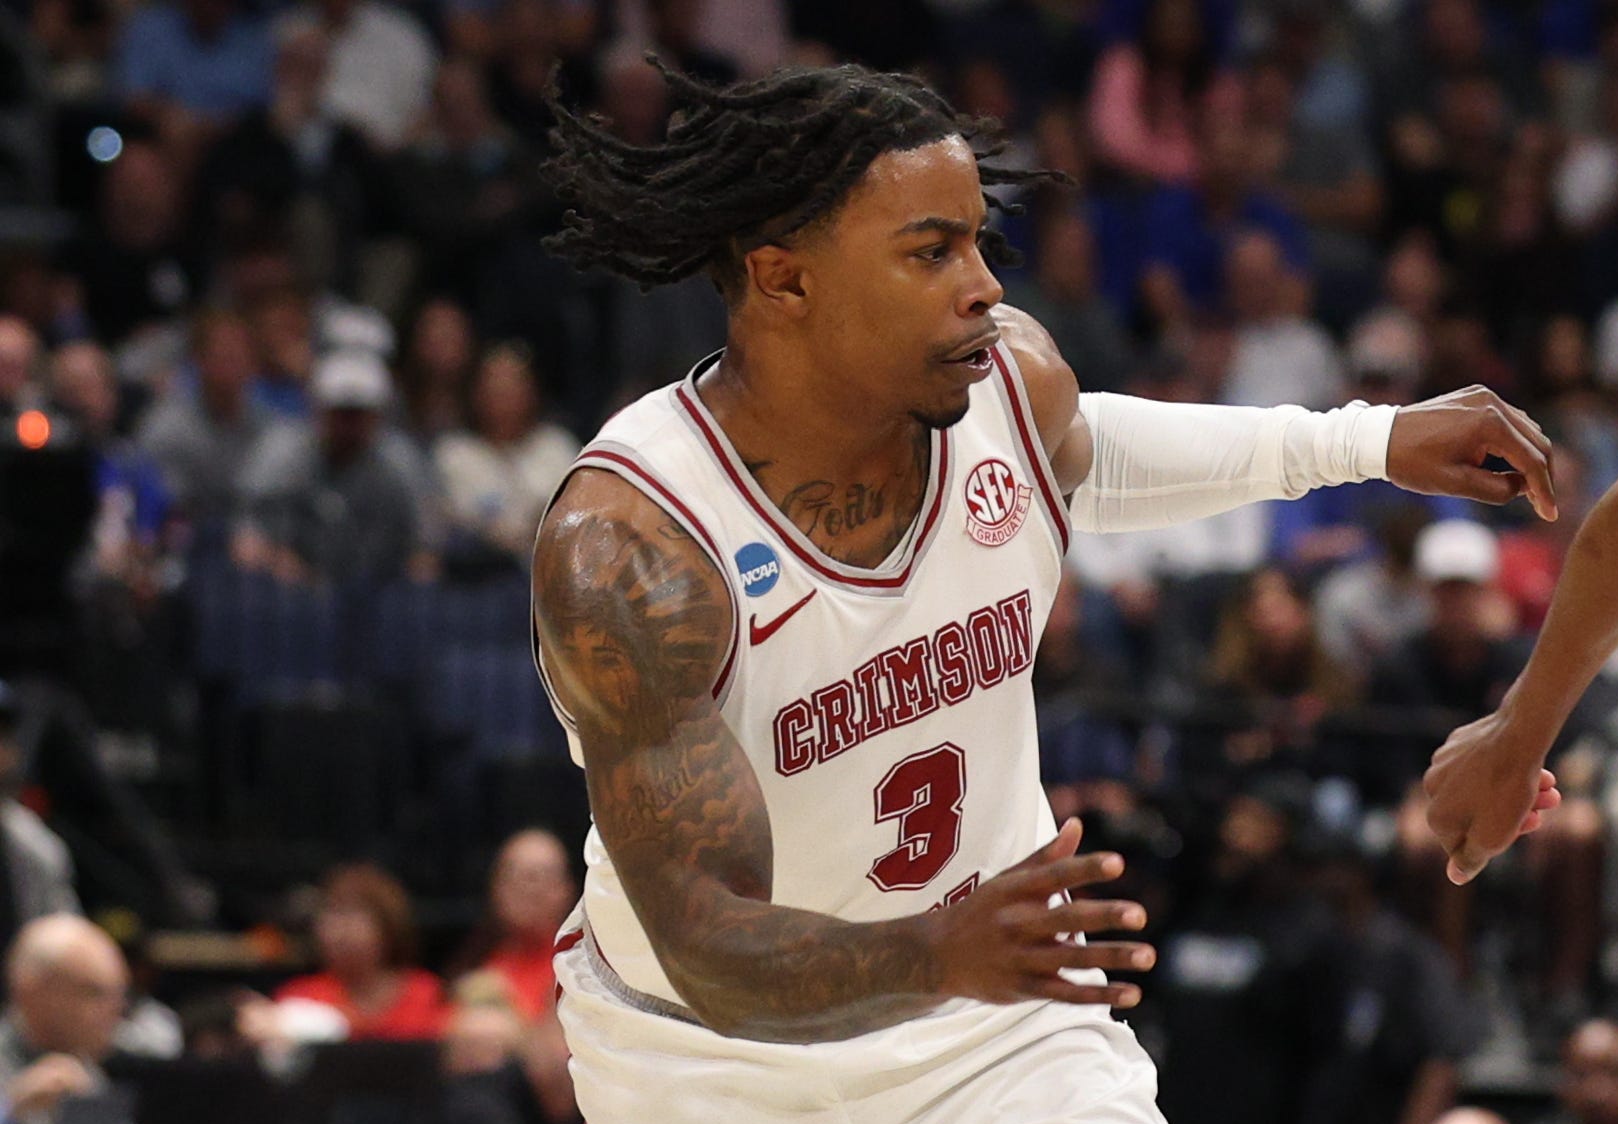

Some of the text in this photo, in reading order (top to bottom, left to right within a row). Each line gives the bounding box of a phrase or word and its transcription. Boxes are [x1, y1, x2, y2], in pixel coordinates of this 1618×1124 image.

[966, 462, 1015, 524] SEC
[975, 504, 1028, 544] GRADUATE
[740, 560, 779, 586] NCAA
[773, 589, 1033, 777] CRIMSON
[866, 741, 967, 892] 3
